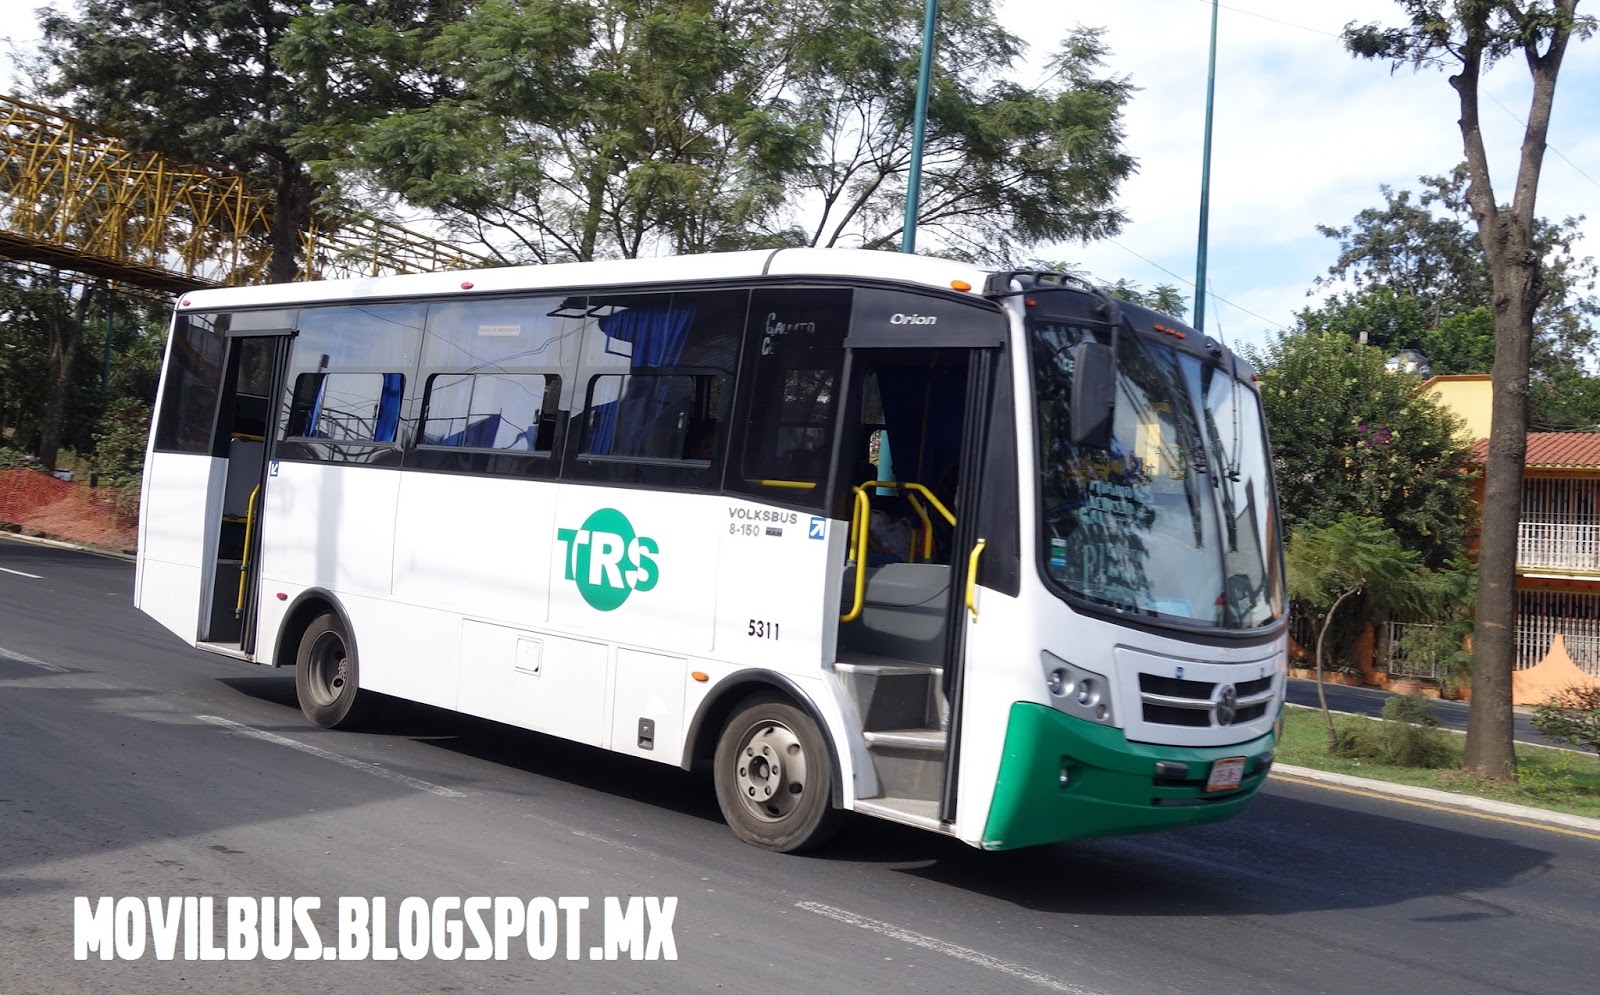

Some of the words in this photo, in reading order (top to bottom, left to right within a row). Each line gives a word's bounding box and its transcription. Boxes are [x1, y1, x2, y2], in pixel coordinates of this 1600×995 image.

[890, 313, 937, 325] Orion
[729, 507, 798, 524] VOLKSBUS
[557, 527, 660, 592] TRS
[748, 619, 779, 641] 5311
